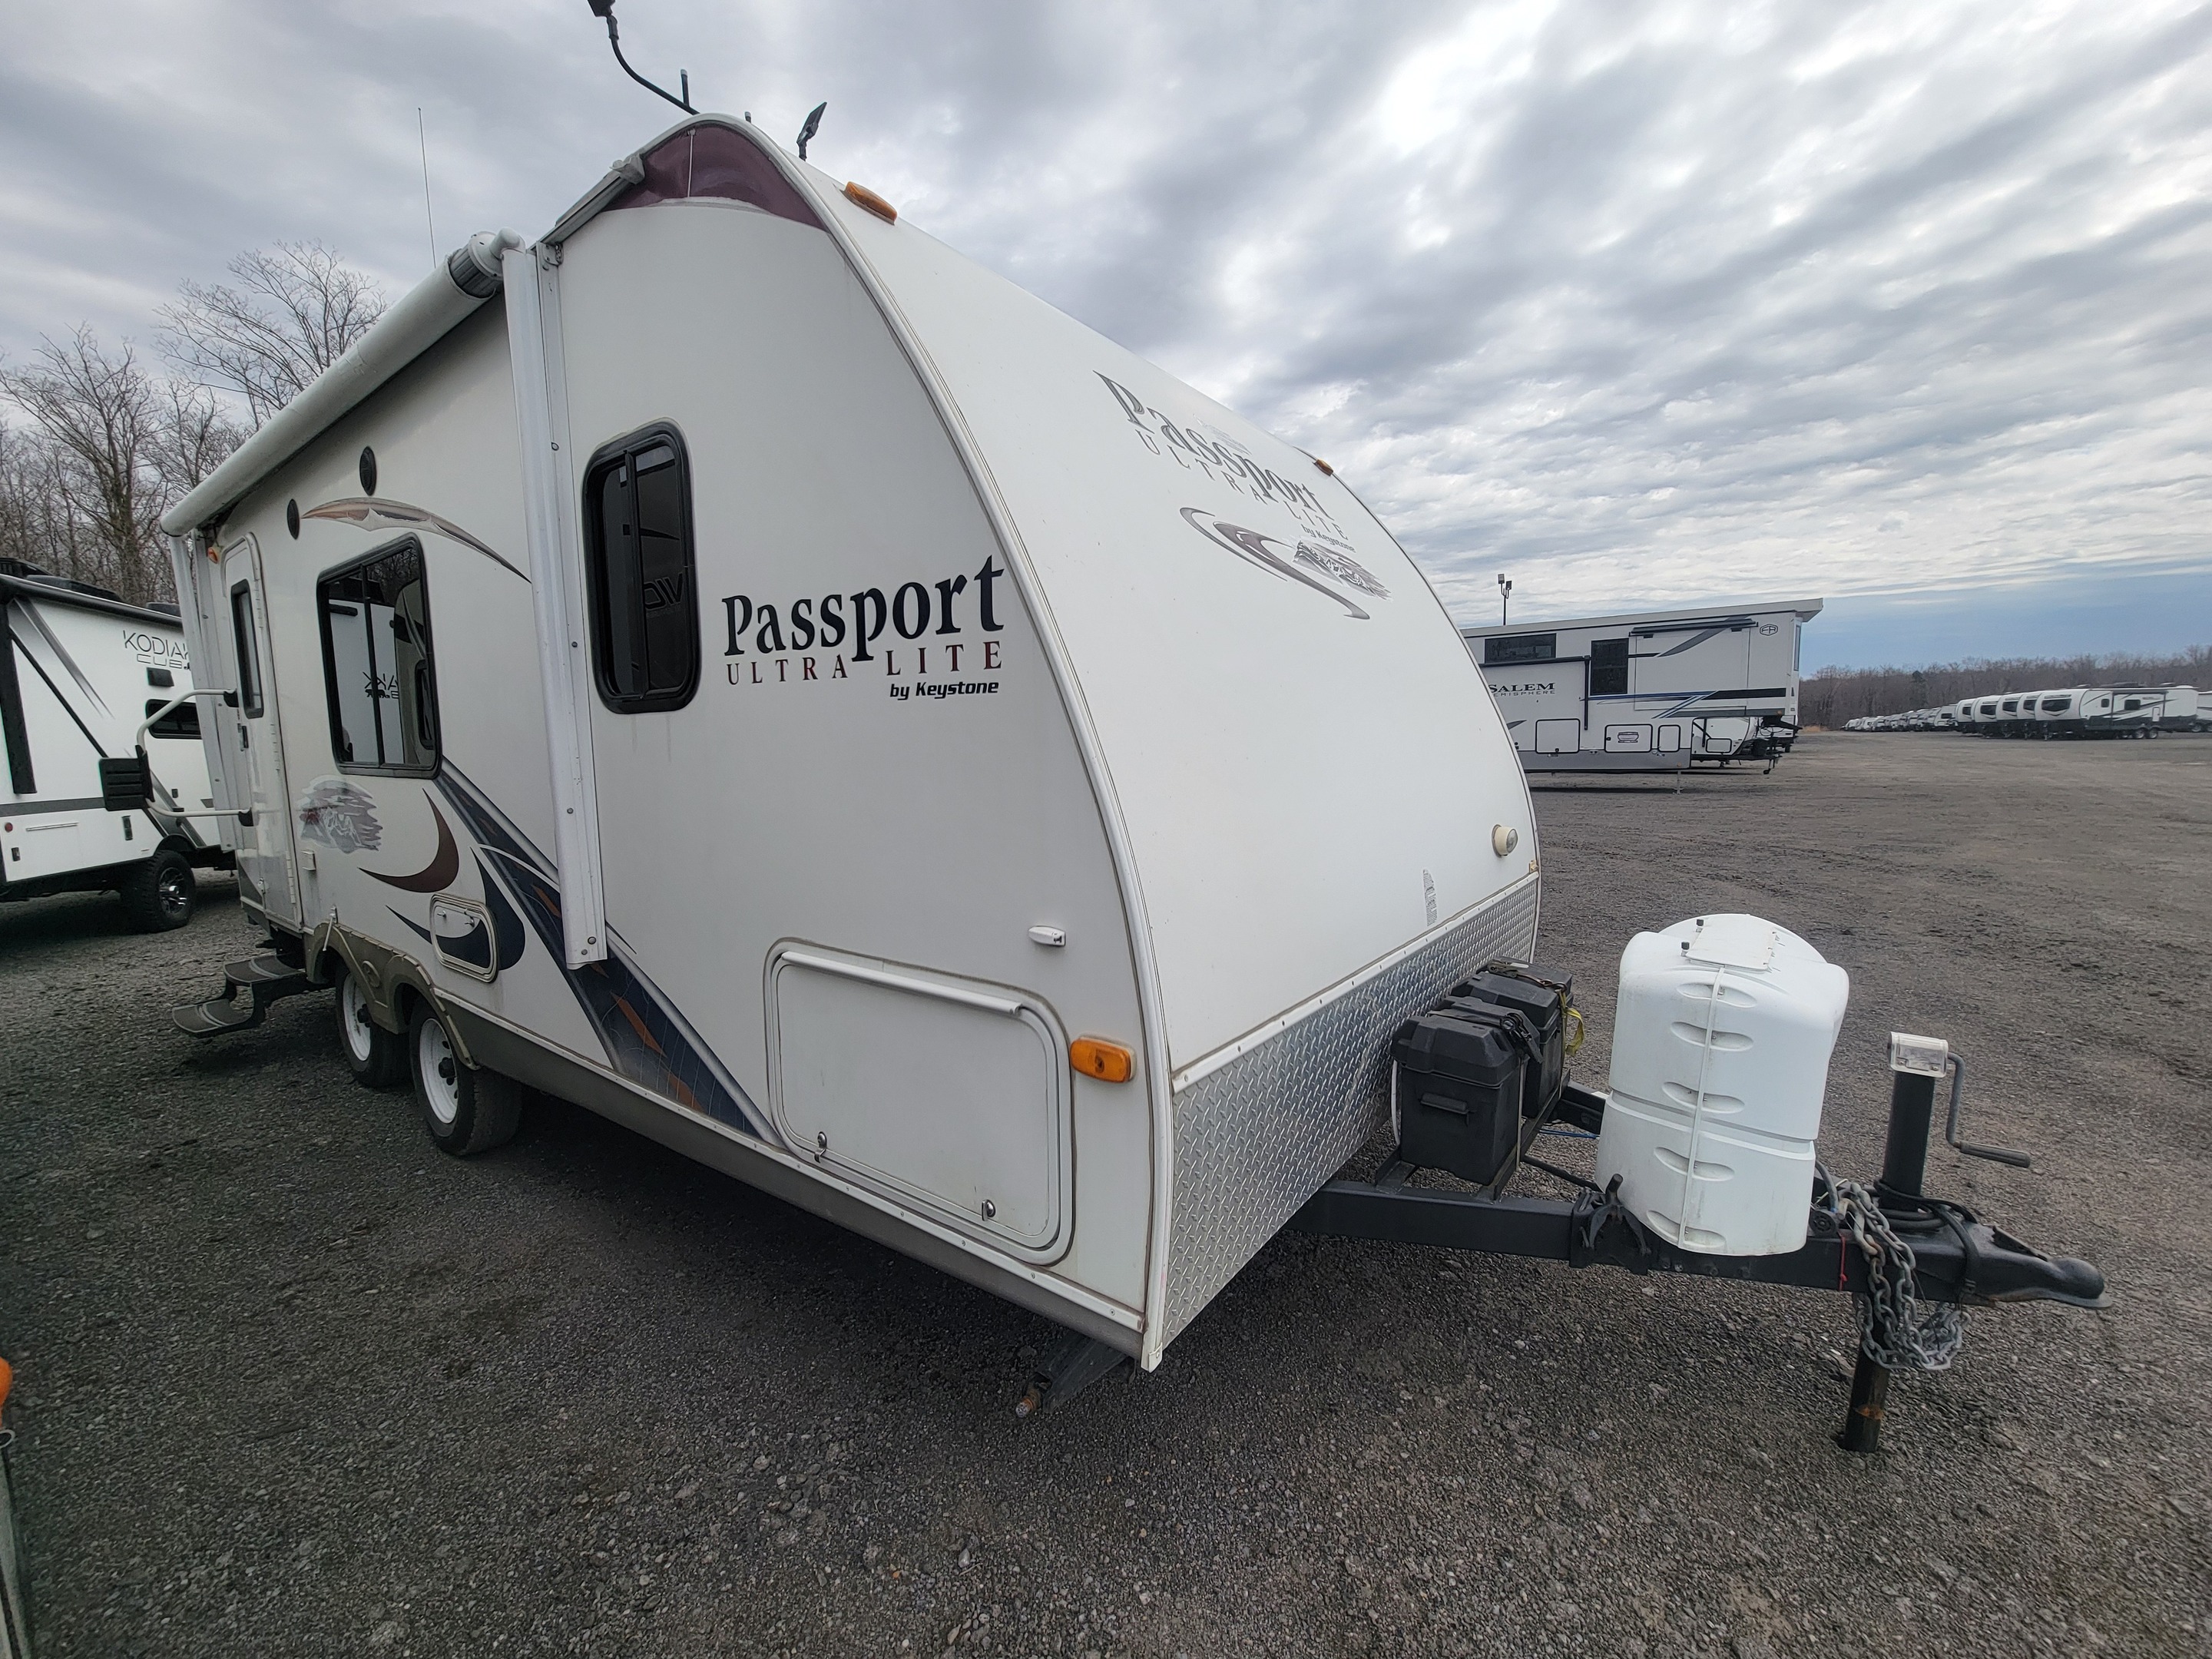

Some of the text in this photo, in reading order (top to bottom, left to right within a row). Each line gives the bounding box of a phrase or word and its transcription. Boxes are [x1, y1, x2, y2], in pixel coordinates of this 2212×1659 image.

[1093, 370, 1335, 521] Passport
[1135, 429, 1349, 541] ULTRA LITE
[1301, 524, 1356, 553] by Keystone
[721, 555, 1005, 662] Passport
[727, 641, 1002, 685] ULTRA LITE
[890, 681, 999, 700] by Keystone
[1488, 683, 1555, 693] SALEM
